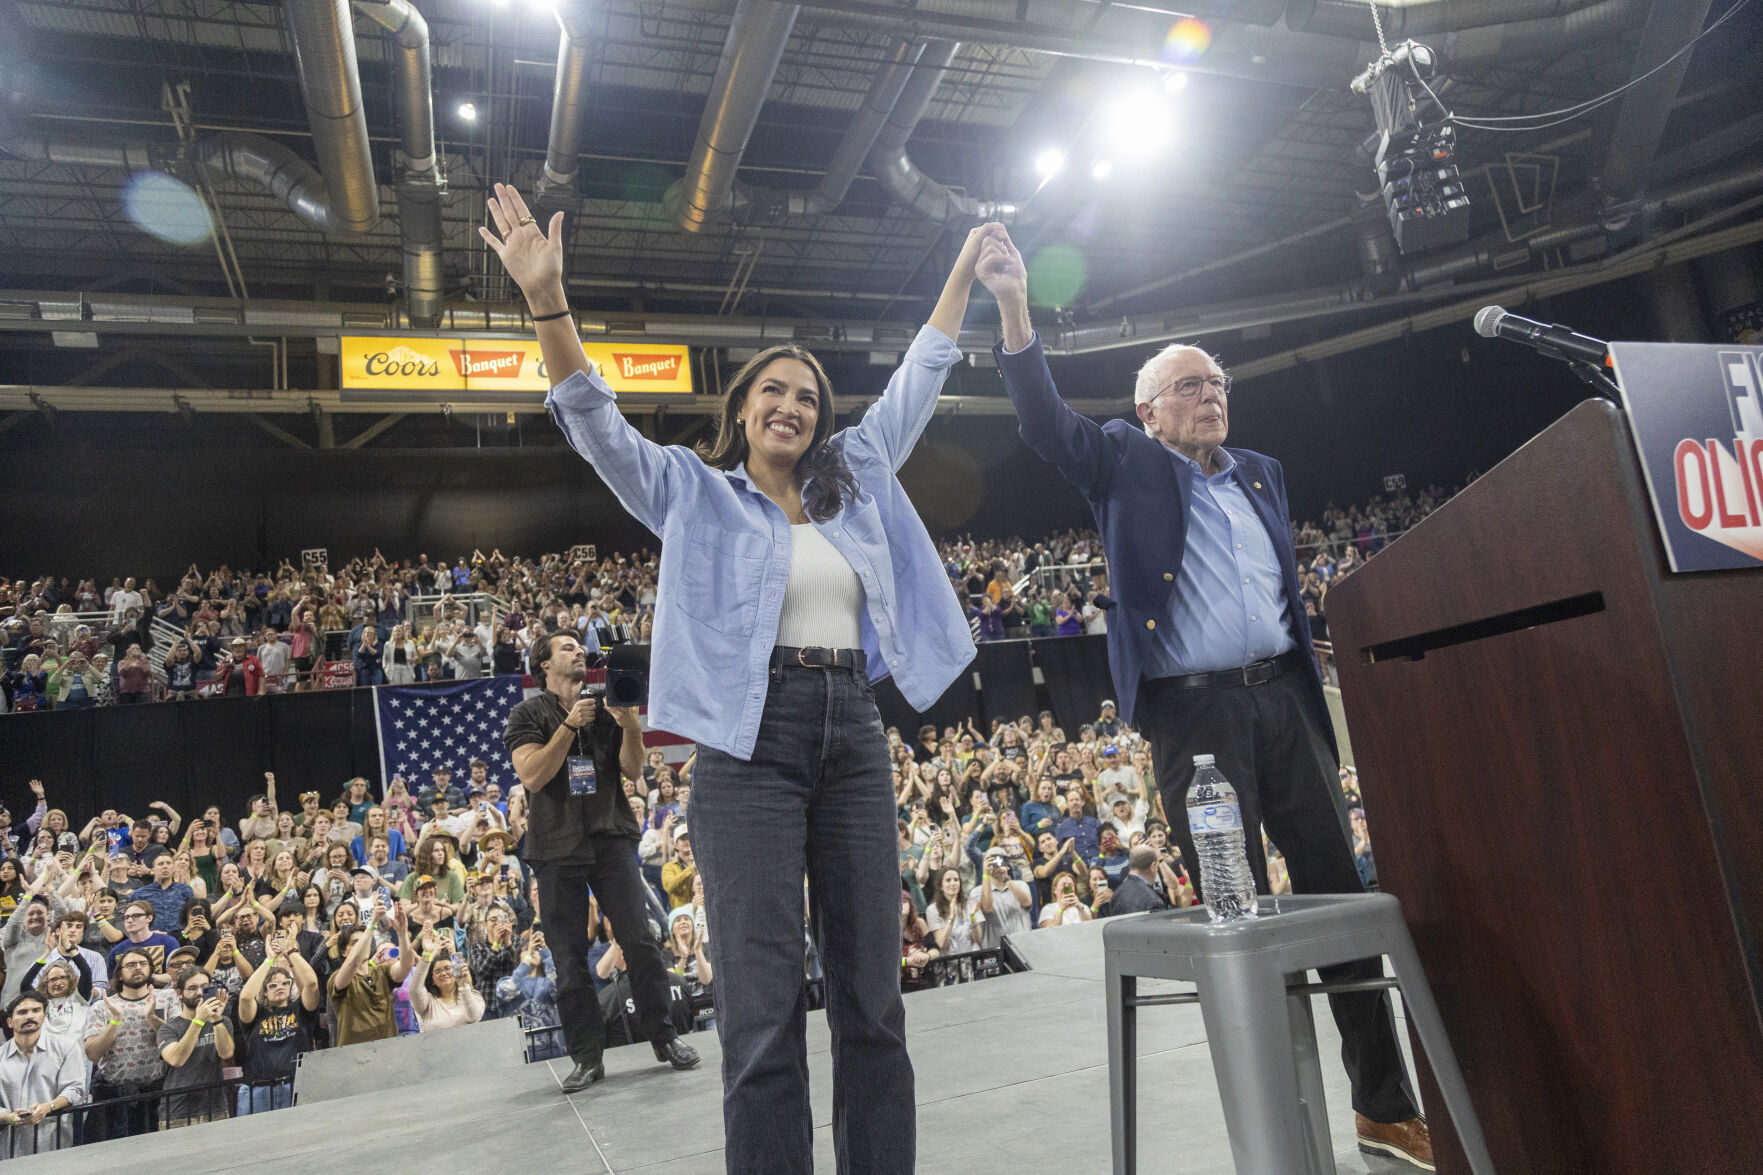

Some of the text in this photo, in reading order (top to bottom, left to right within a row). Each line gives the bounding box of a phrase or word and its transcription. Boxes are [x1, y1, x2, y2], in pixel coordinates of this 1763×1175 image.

[364, 352, 441, 376] Coors
[460, 353, 518, 375] Banquet
[622, 356, 676, 377] Banquet
[1717, 351, 1763, 433] FI
[575, 547, 595, 559] C56
